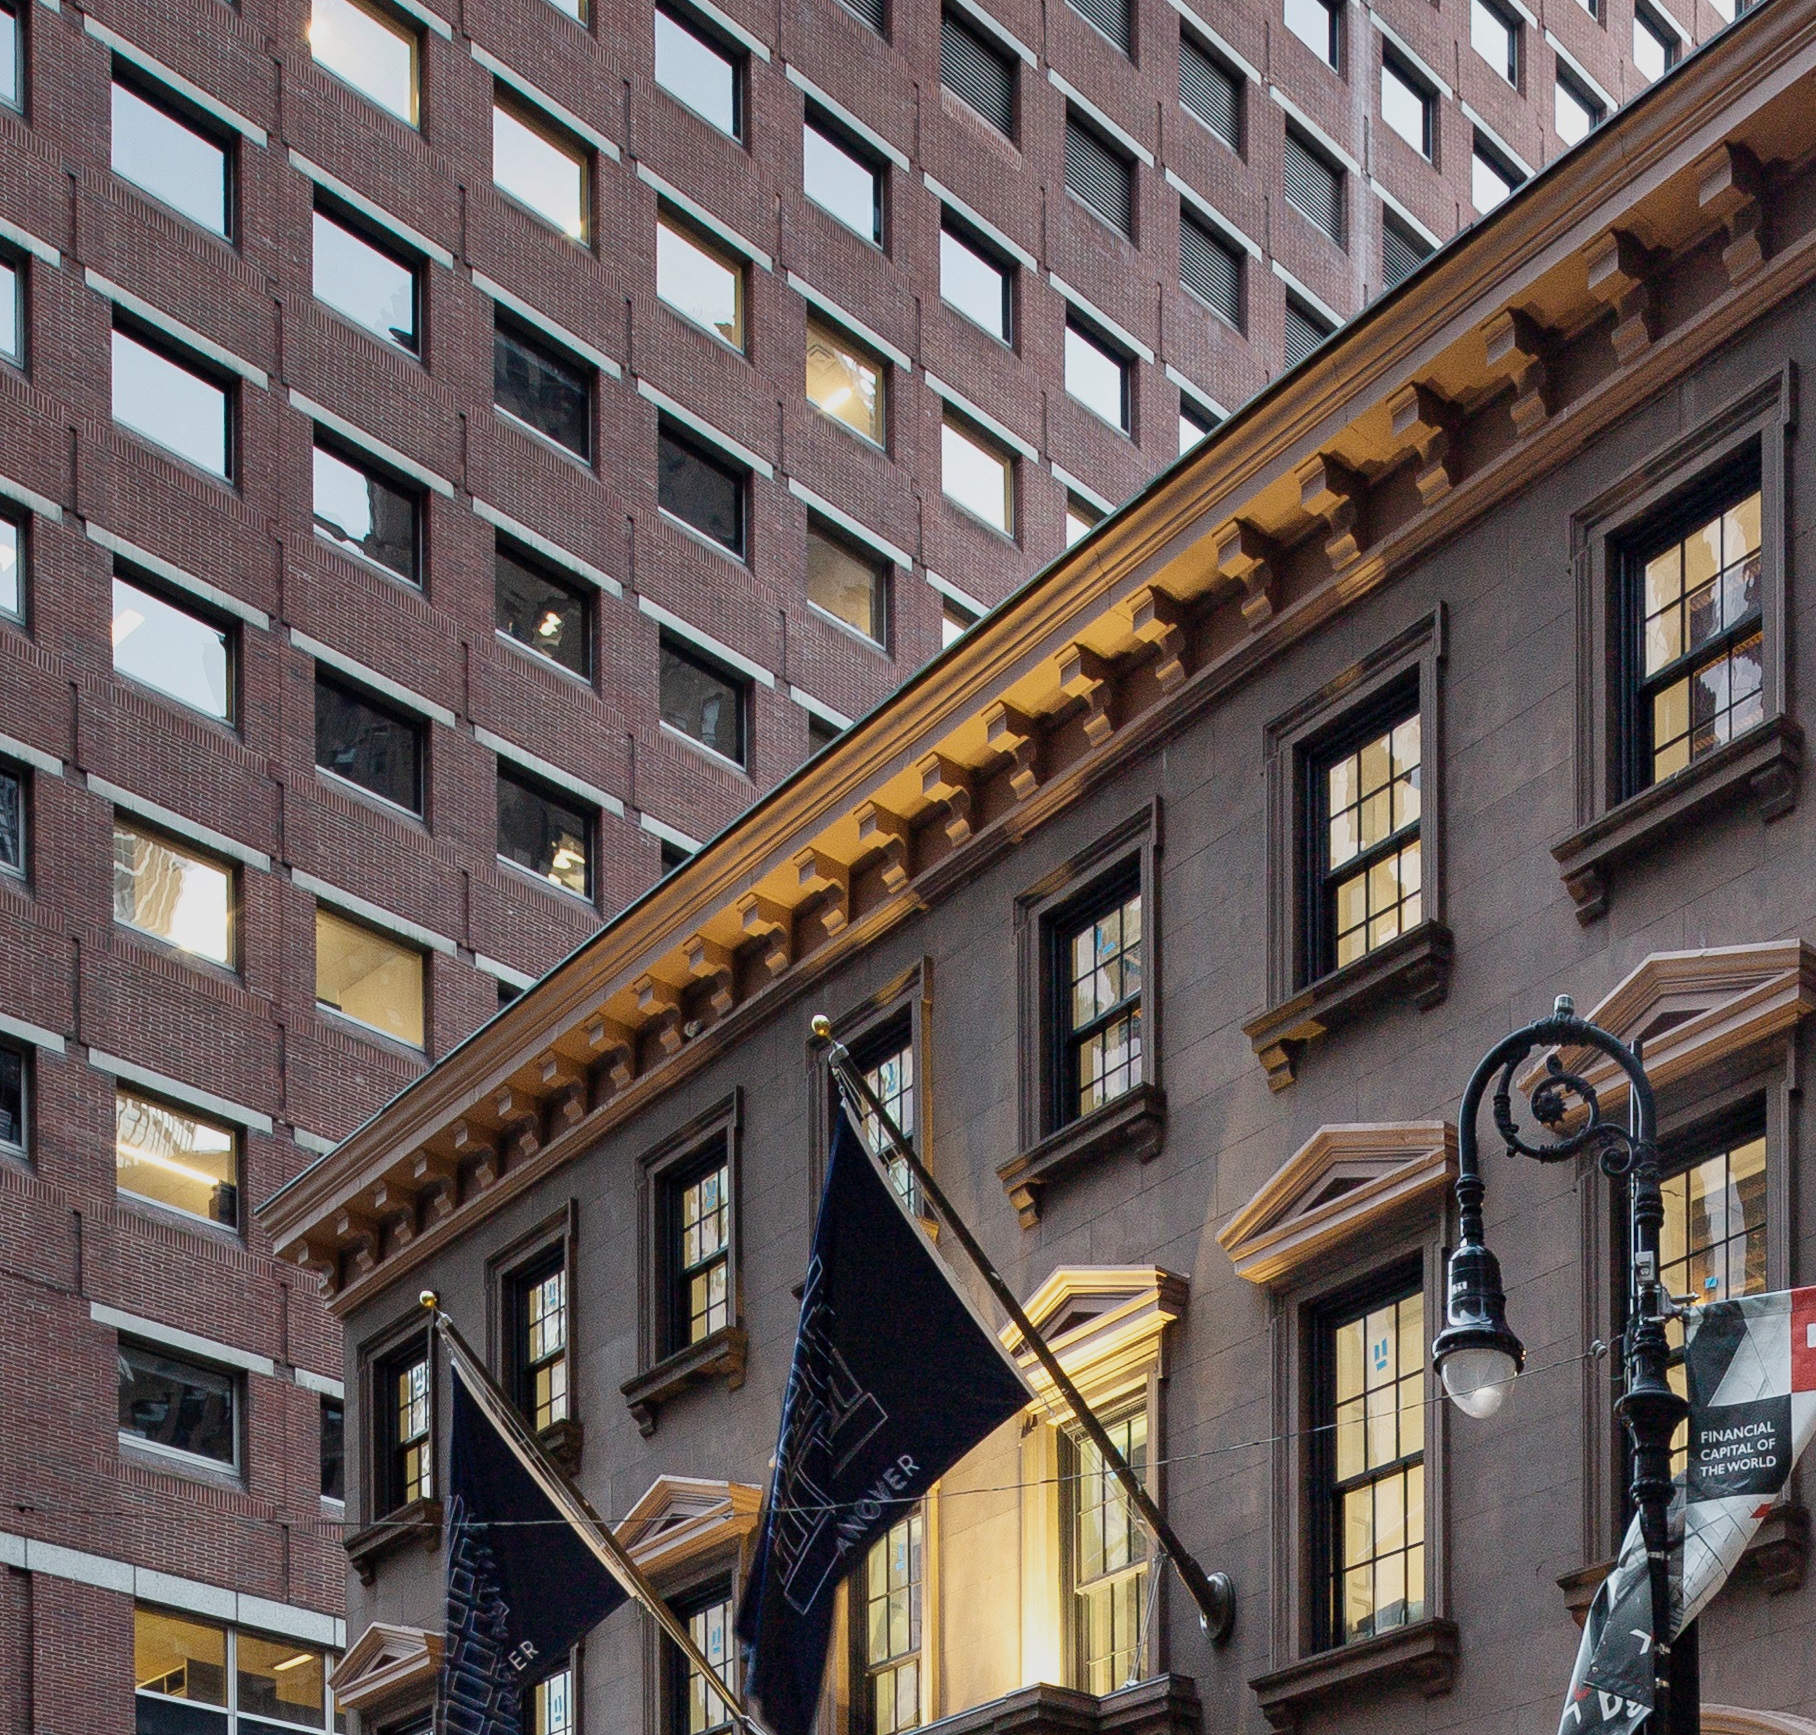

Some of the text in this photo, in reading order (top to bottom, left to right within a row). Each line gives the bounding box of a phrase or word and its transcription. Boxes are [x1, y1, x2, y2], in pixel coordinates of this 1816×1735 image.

[1701, 1421, 1775, 1443] FINANCIAL
[1701, 1438, 1777, 1461] CAPITAL OF
[1700, 1456, 1777, 1477] THE WORLD
[836, 1454, 920, 1556] ANOVER
